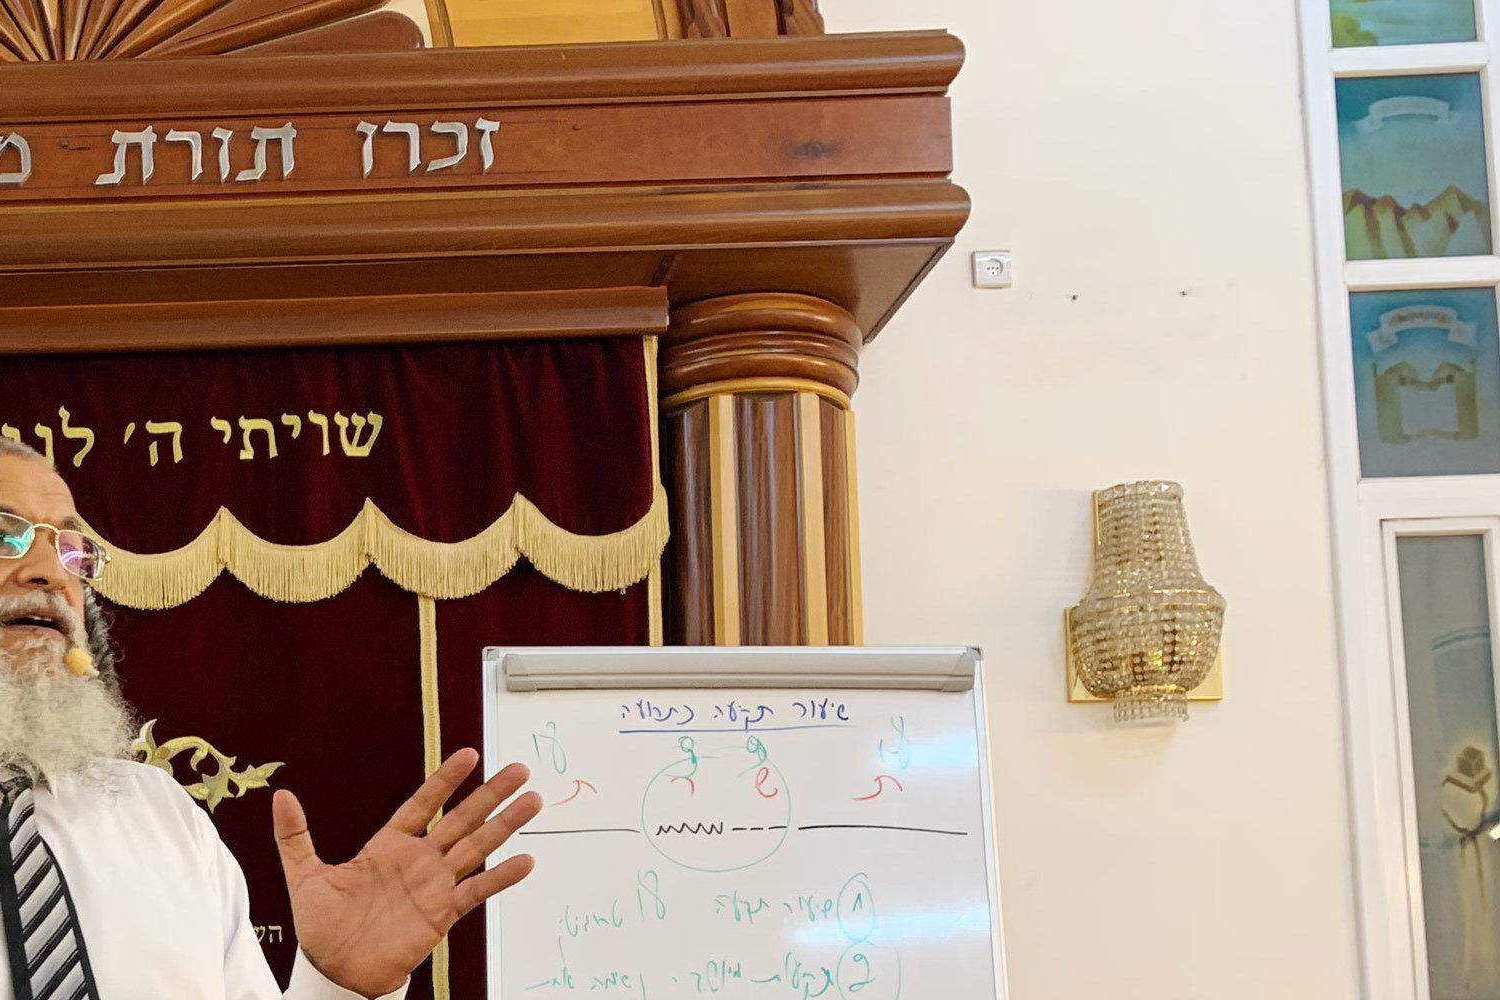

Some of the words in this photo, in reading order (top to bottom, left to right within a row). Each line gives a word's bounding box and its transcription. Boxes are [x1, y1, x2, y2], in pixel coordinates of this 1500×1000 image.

[94, 120, 298, 187] תורת
[355, 116, 500, 176] זכרו
[211, 410, 384, 460] שויתי
[712, 700, 775, 733] תקיעה
[792, 697, 851, 722] שיעור
